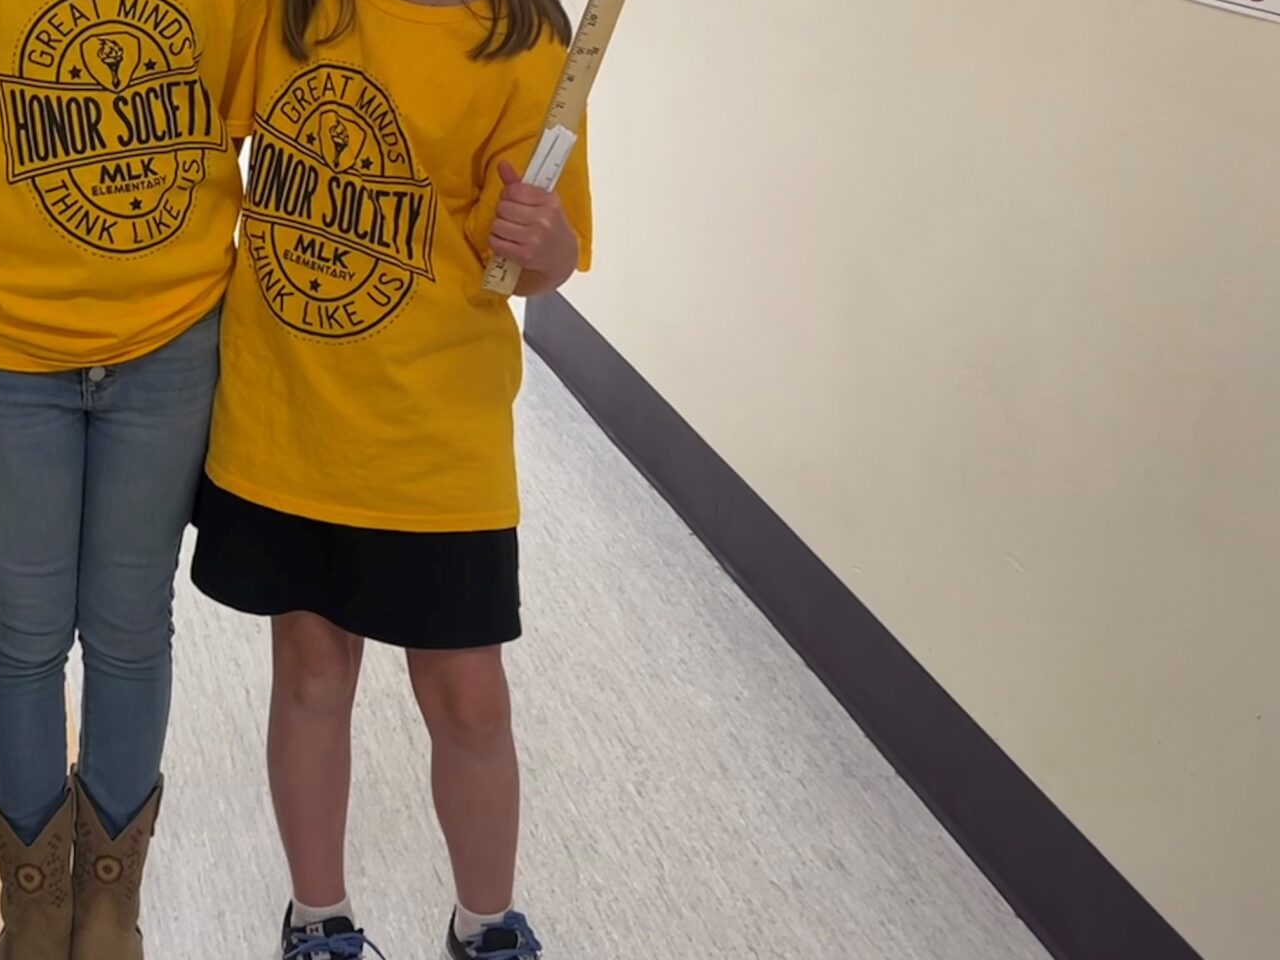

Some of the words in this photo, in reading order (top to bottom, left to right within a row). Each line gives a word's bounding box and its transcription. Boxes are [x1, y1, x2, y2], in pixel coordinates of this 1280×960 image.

[10, 88, 107, 167] HONOR
[279, 72, 354, 124] GREAT
[356, 88, 406, 165] MINDS
[45, 179, 118, 244] THINK
[132, 199, 182, 244] LIKE
[177, 159, 201, 192] US
[91, 176, 168, 197] ELEMENTARY
[99, 157, 159, 184] MLK
[245, 130, 320, 220] HONOR
[322, 176, 423, 261] SOCIETY
[249, 230, 295, 312] THINK
[302, 300, 365, 329] LIKE
[368, 272, 405, 308] US
[283, 251, 356, 282] ELEMENTARY
[293, 235, 352, 270] MLK
